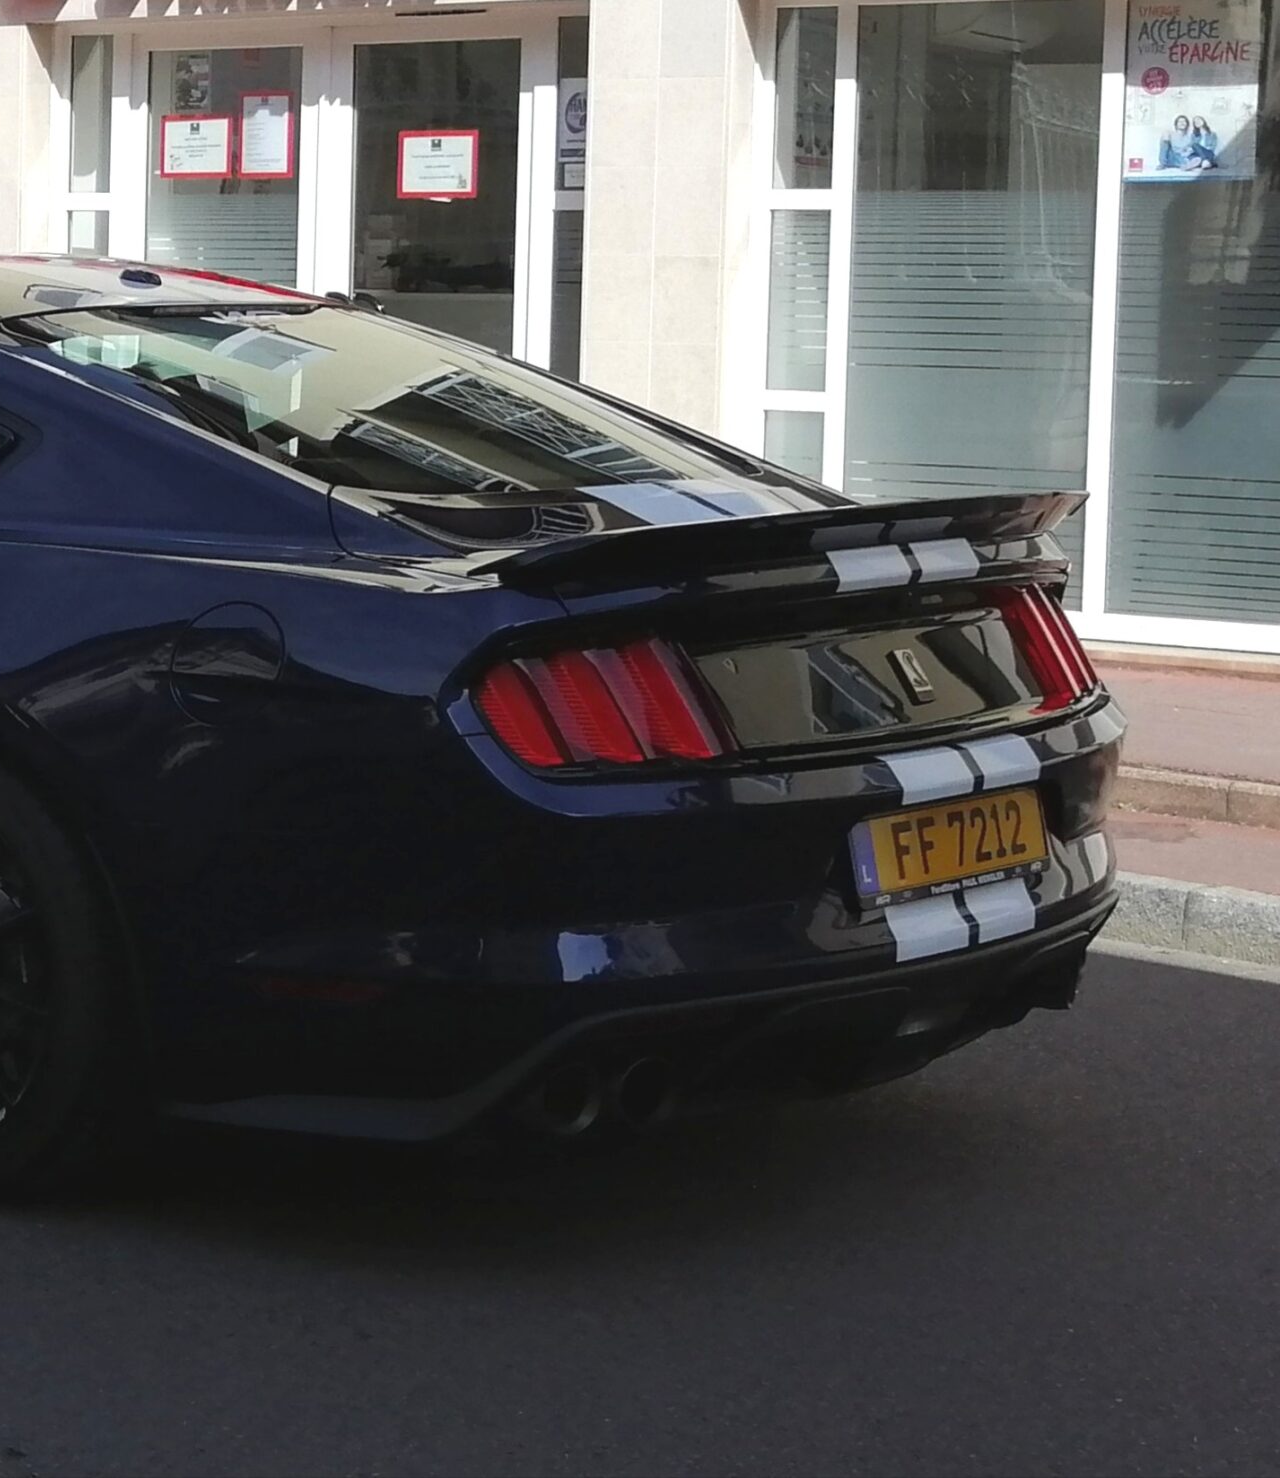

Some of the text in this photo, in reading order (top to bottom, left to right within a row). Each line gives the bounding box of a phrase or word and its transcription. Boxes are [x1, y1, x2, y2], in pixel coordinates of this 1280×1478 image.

[1138, 15, 1220, 44] ACCÉLÈRE
[1168, 40, 1252, 64] ÉPARGNE
[890, 799, 1027, 881] FF 7212
[861, 864, 873, 885] L
